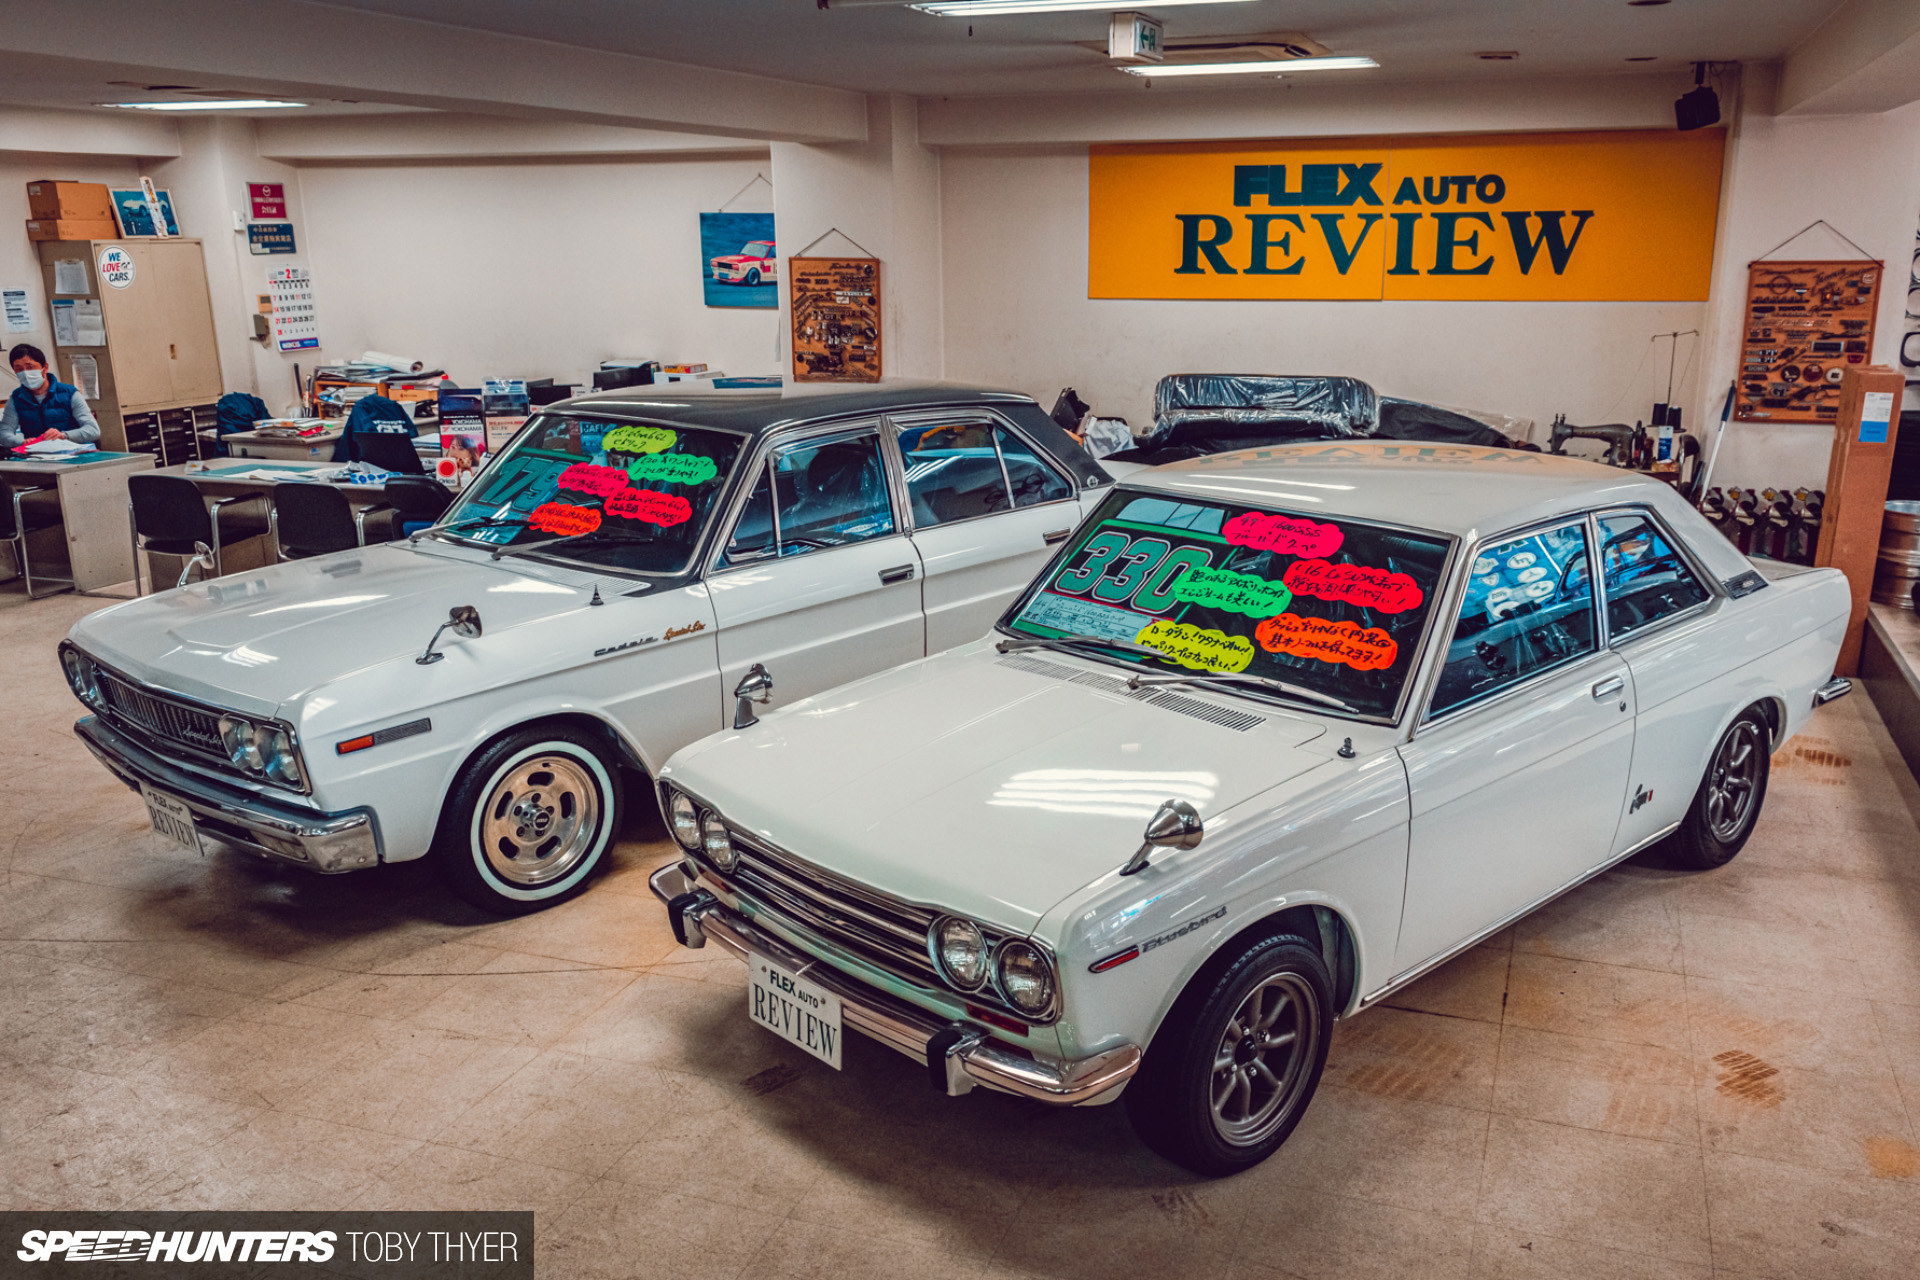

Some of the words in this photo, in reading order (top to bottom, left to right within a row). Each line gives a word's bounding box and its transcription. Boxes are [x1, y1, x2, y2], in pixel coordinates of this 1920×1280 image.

[1234, 163, 1384, 206] FLEX
[1393, 174, 1505, 206] AUTO
[109, 252, 121, 262] WE
[1174, 210, 1595, 276] REVIEW
[102, 262, 121, 273] LOVE
[285, 268, 291, 279] 2
[1054, 531, 1214, 615] 330
[148, 804, 197, 850] REVIEW
[1142, 905, 1228, 953] Bluebird
[769, 968, 796, 995] FLEX
[797, 988, 820, 1009] AUTO
[752, 982, 837, 1061] REVIEW
